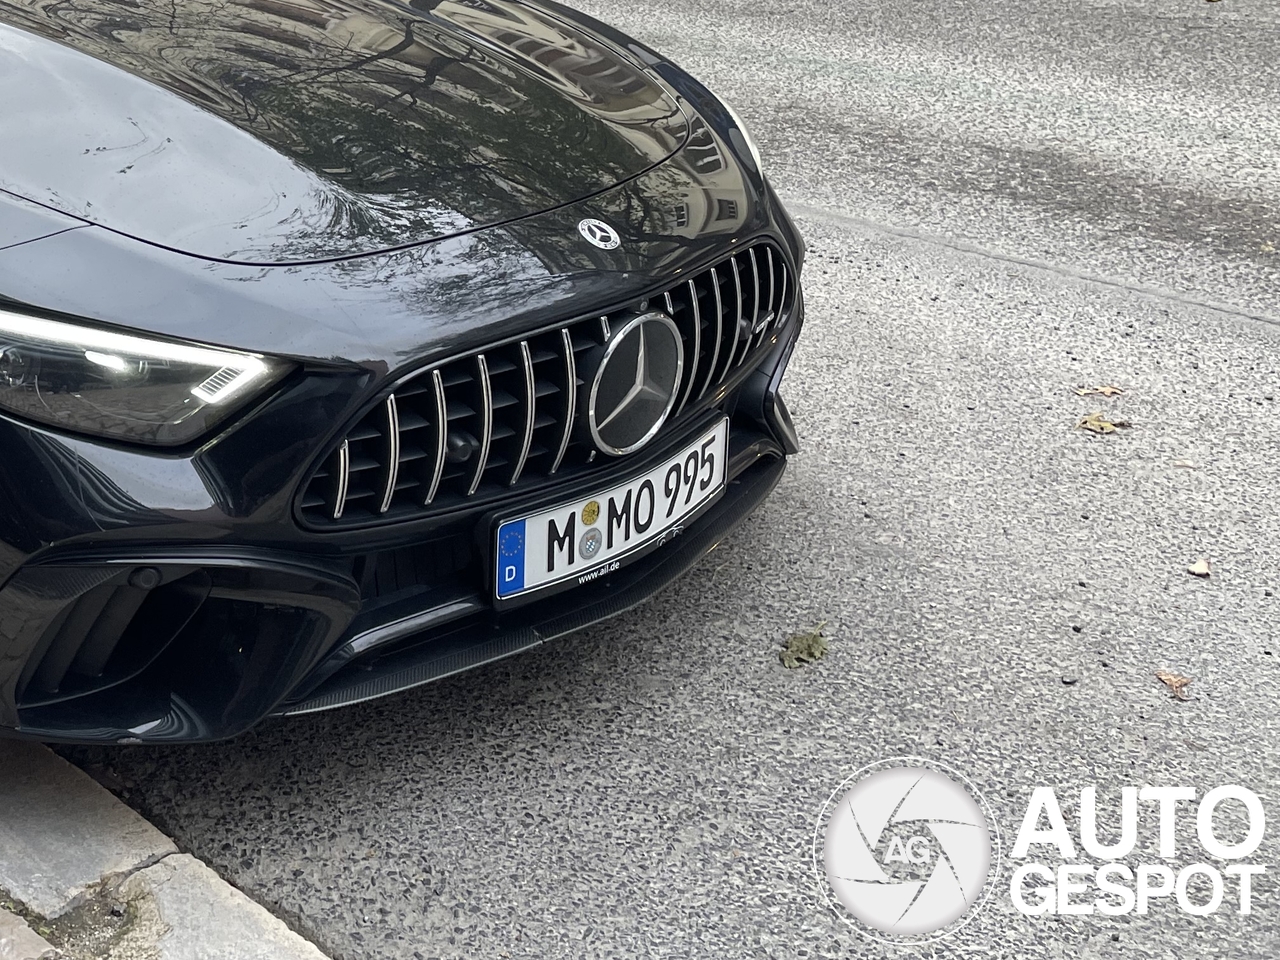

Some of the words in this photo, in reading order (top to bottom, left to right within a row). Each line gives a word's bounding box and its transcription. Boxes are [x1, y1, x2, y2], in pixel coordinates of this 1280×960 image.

[547, 511, 576, 573] M
[607, 479, 655, 550] MO
[664, 434, 716, 519] 995
[505, 565, 516, 582] D
[578, 560, 620, 585] www.ail.de
